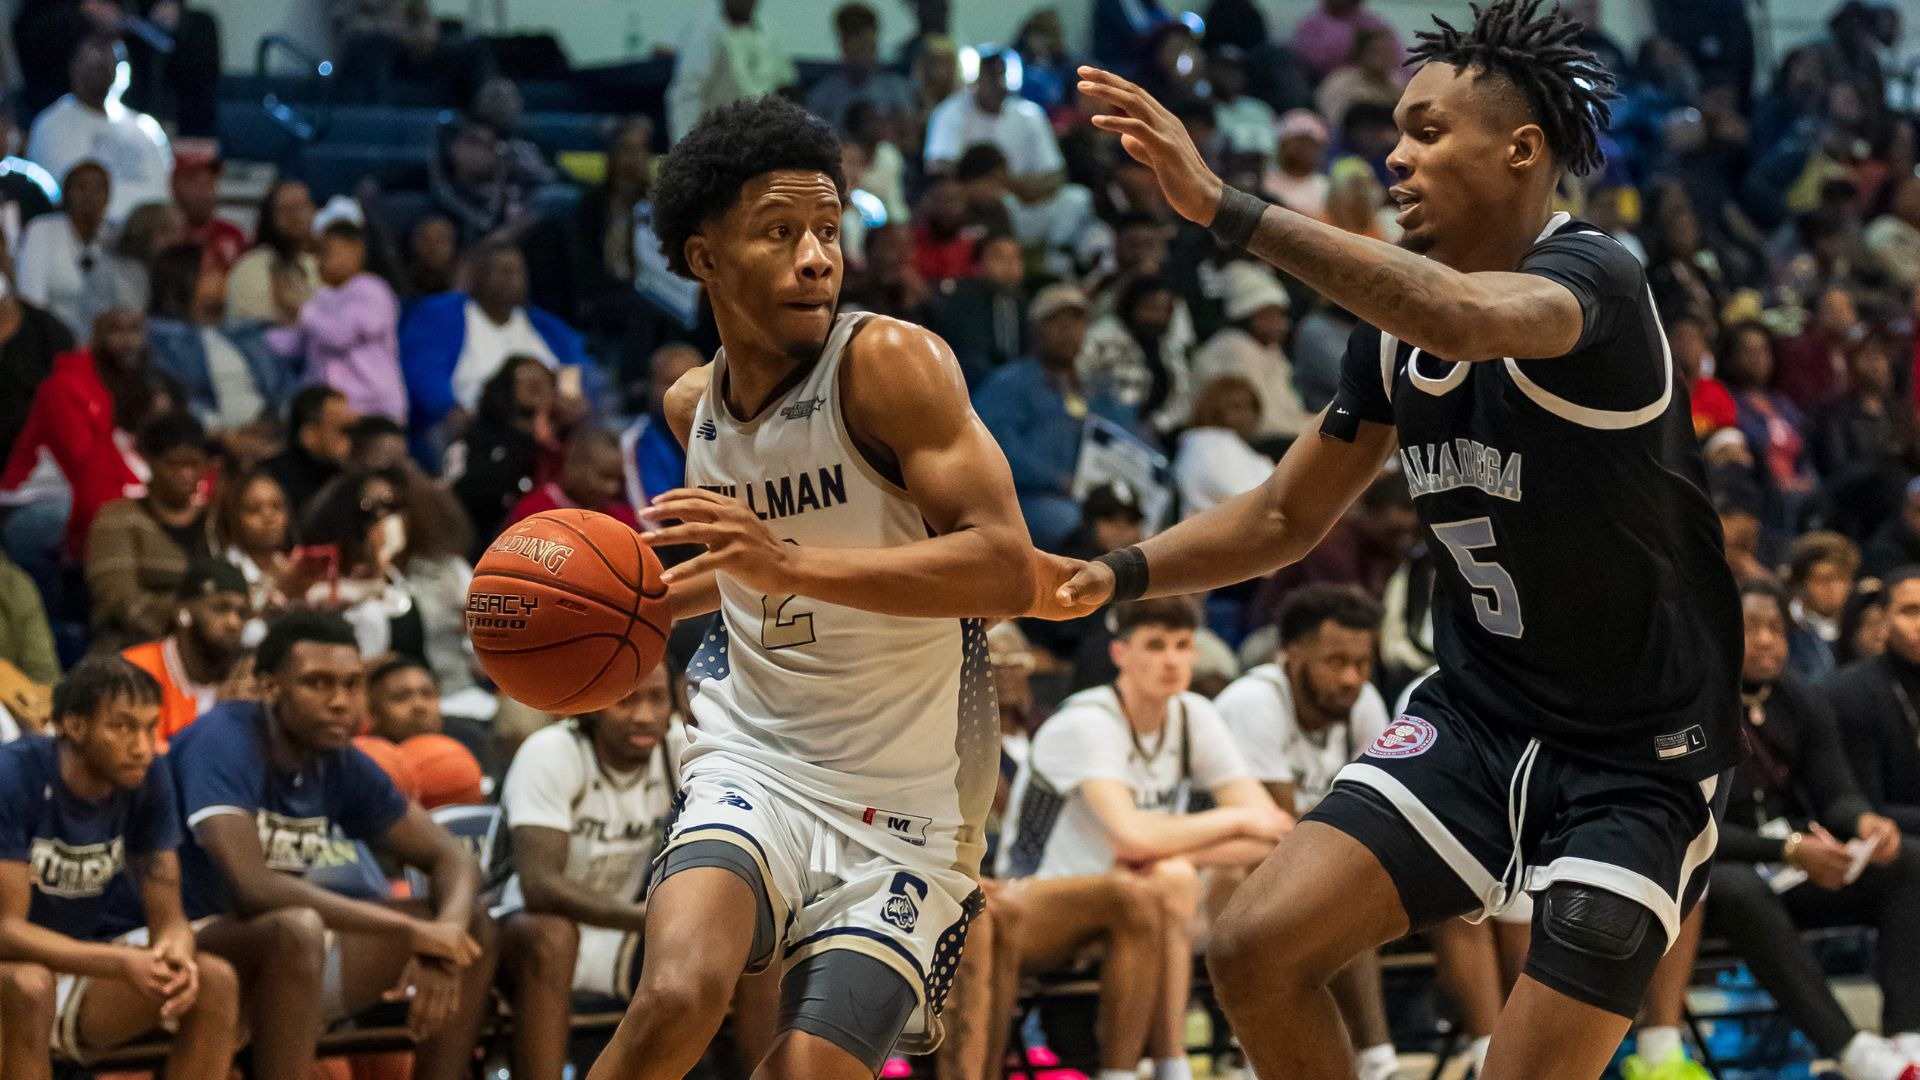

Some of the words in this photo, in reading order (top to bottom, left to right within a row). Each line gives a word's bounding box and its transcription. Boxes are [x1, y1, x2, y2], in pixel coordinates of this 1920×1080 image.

[1430, 516, 1525, 639] 5
[466, 592, 539, 616] EGACY
[1691, 734, 1700, 745] L
